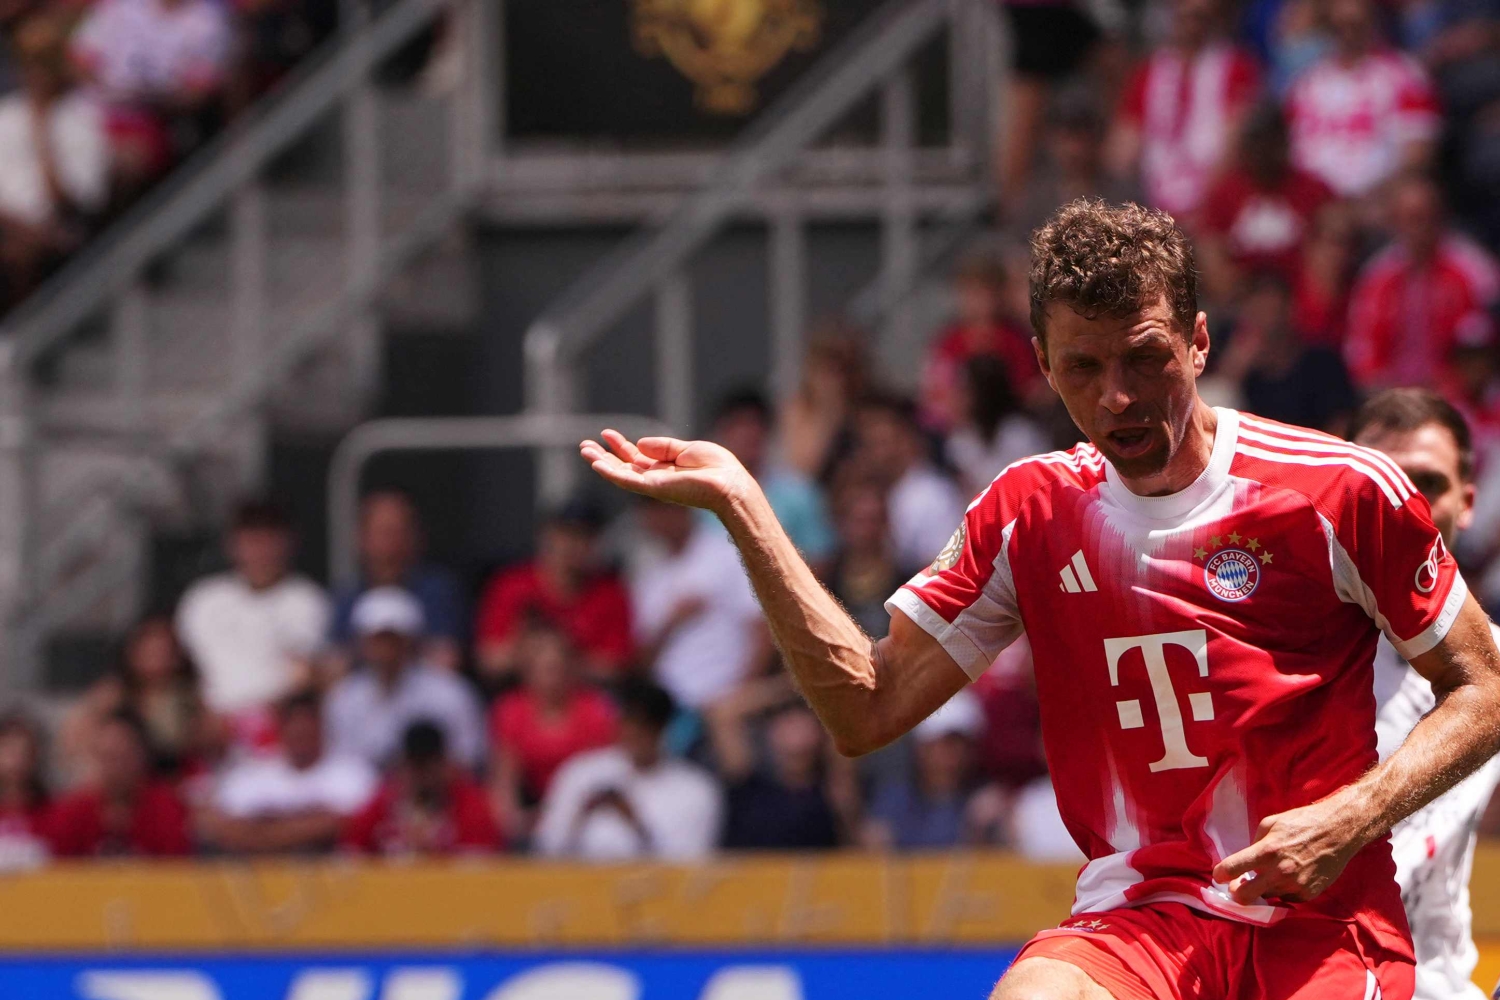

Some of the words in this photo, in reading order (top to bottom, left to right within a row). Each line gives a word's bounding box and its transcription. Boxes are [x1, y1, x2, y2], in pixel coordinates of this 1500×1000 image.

[1209, 558, 1221, 571] FC
[1221, 552, 1256, 573] BAYERN
[1208, 578, 1255, 599] MÜNCHEN
[1103, 629, 1215, 773] T
